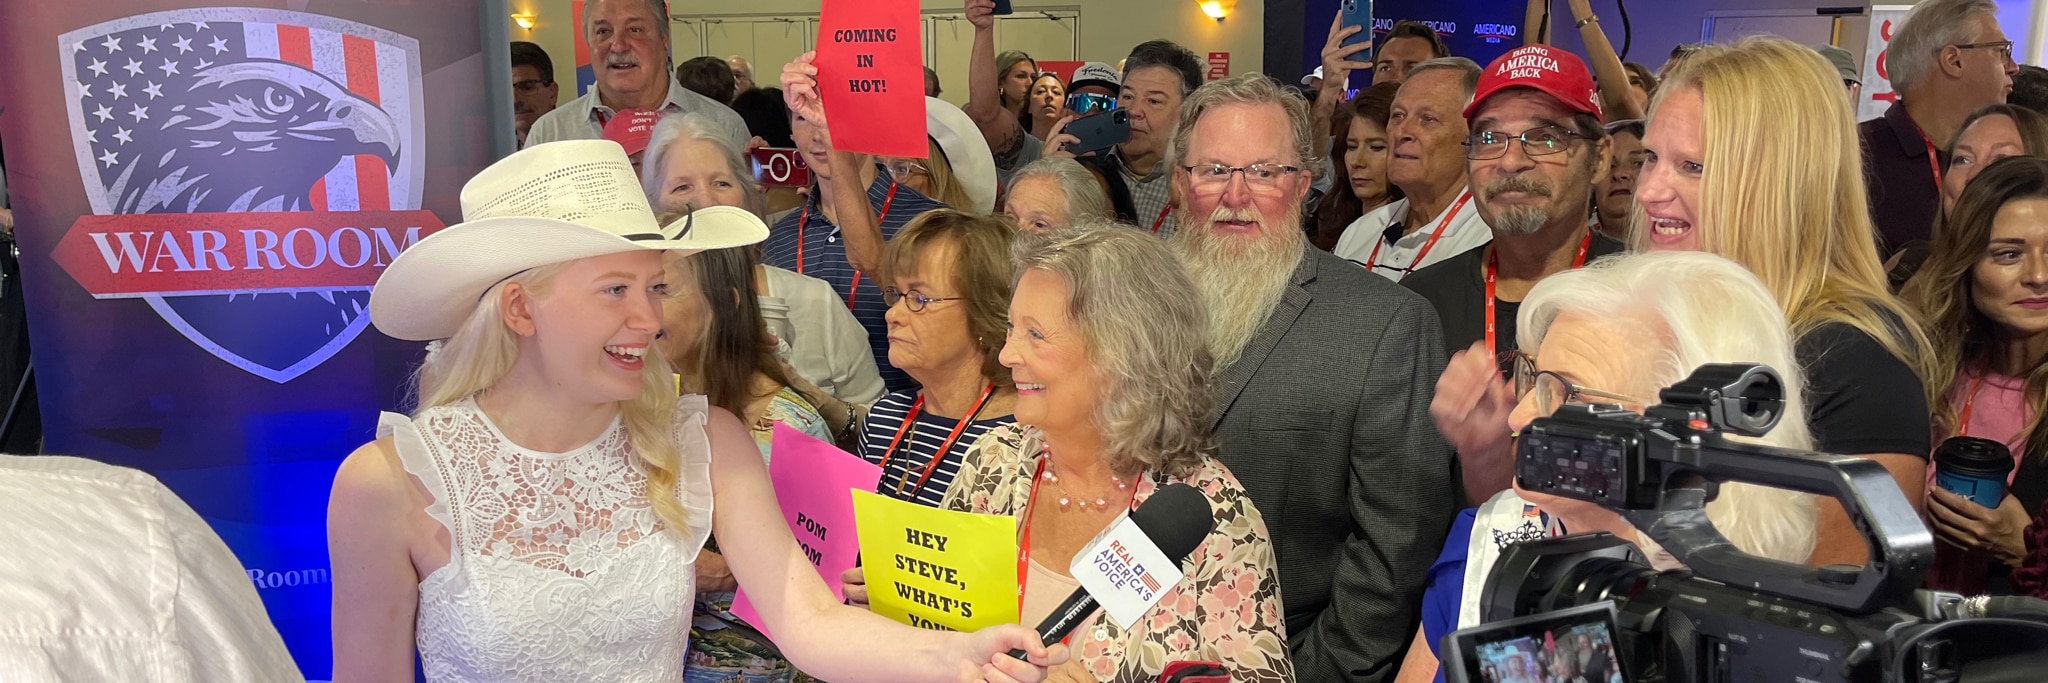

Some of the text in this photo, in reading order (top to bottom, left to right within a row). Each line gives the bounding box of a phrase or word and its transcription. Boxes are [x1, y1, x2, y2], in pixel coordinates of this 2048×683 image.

[834, 28, 897, 43] COMING
[1473, 23, 1517, 36] AMERICANO
[856, 54, 873, 68] IN
[1495, 54, 1560, 76] AMERICA
[1512, 46, 1548, 58] BRING
[848, 79, 887, 93] HOT!
[1510, 67, 1541, 80] BACK
[88, 226, 423, 274] WAR ROOM
[796, 511, 827, 542] POM
[905, 527, 948, 553] HEY
[796, 538, 822, 567] OM
[1110, 539, 1134, 568] REAL
[894, 553, 967, 591] STEVE,
[1093, 554, 1126, 591] VOICE
[1100, 548, 1153, 602] AMERICA'S
[893, 580, 973, 619] WHAT'S
